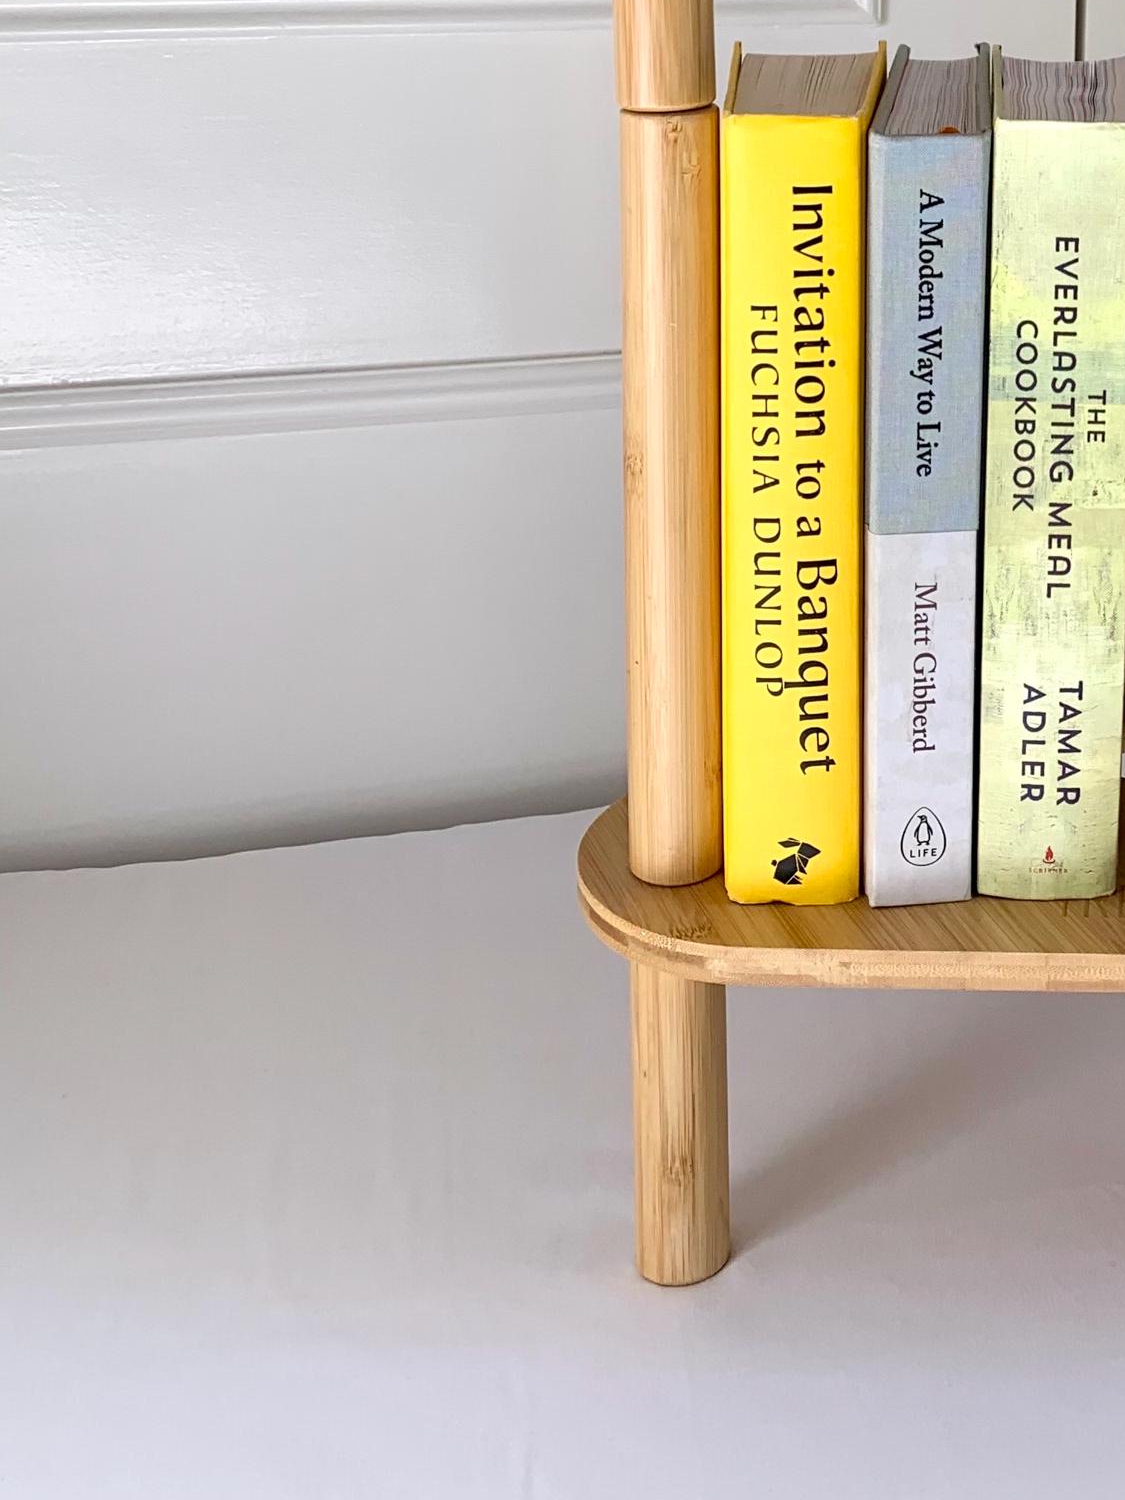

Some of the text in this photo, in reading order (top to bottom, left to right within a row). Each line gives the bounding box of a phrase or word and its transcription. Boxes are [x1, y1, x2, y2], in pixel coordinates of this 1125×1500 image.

[909, 188, 945, 478] A Modern Way to Live
[1012, 320, 1039, 511] COOKBOOK
[1046, 236, 1080, 599] EVERLASTING MEAL
[1087, 389, 1107, 443] THE
[750, 305, 784, 697] FUCHSIA DUNLOP
[783, 185, 838, 775] Invitation to a Banquet
[912, 582, 938, 754] Matt Gibberd
[1020, 683, 1047, 802] ADLER
[1056, 680, 1084, 806] TAMAR
[909, 847, 938, 859] LIFE
